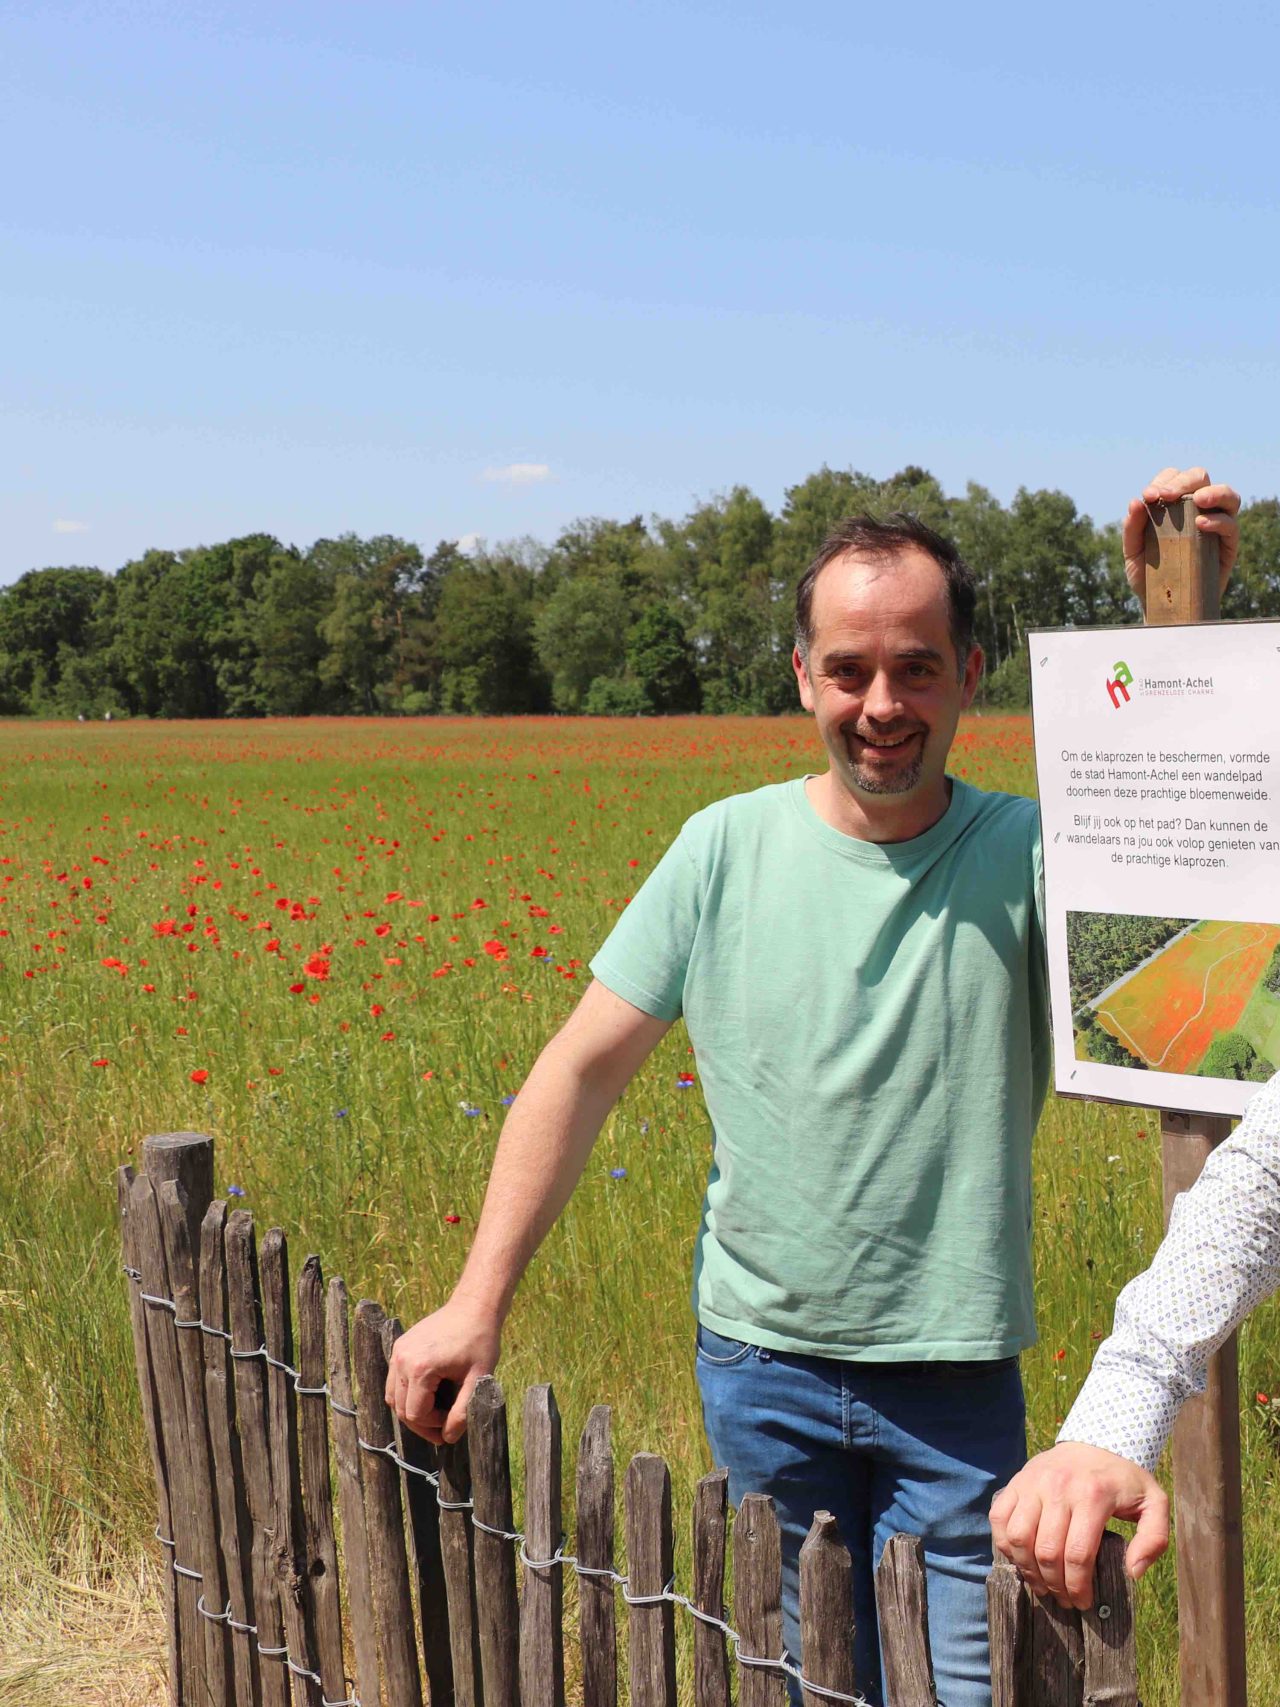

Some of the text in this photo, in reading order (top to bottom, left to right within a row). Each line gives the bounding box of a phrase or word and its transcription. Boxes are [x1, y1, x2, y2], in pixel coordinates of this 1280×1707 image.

[1144, 677, 1213, 689] Hamont-Achel
[1188, 688, 1215, 696] CHARME
[1061, 750, 1270, 764] Om de klaprozen te beschermen, vormde
[1070, 768, 1262, 784] de stad Hamont-Achel een wandelpad
[1066, 785, 1271, 801] doorheen deze prachtige bloemenweide.
[1074, 814, 1268, 832] Blijf jij ook op het pad? Dan kunnen de
[1066, 833, 1280, 852] wandelaars na jou ook volop genieten van
[1111, 851, 1229, 868] de prachtige klaprozen.
